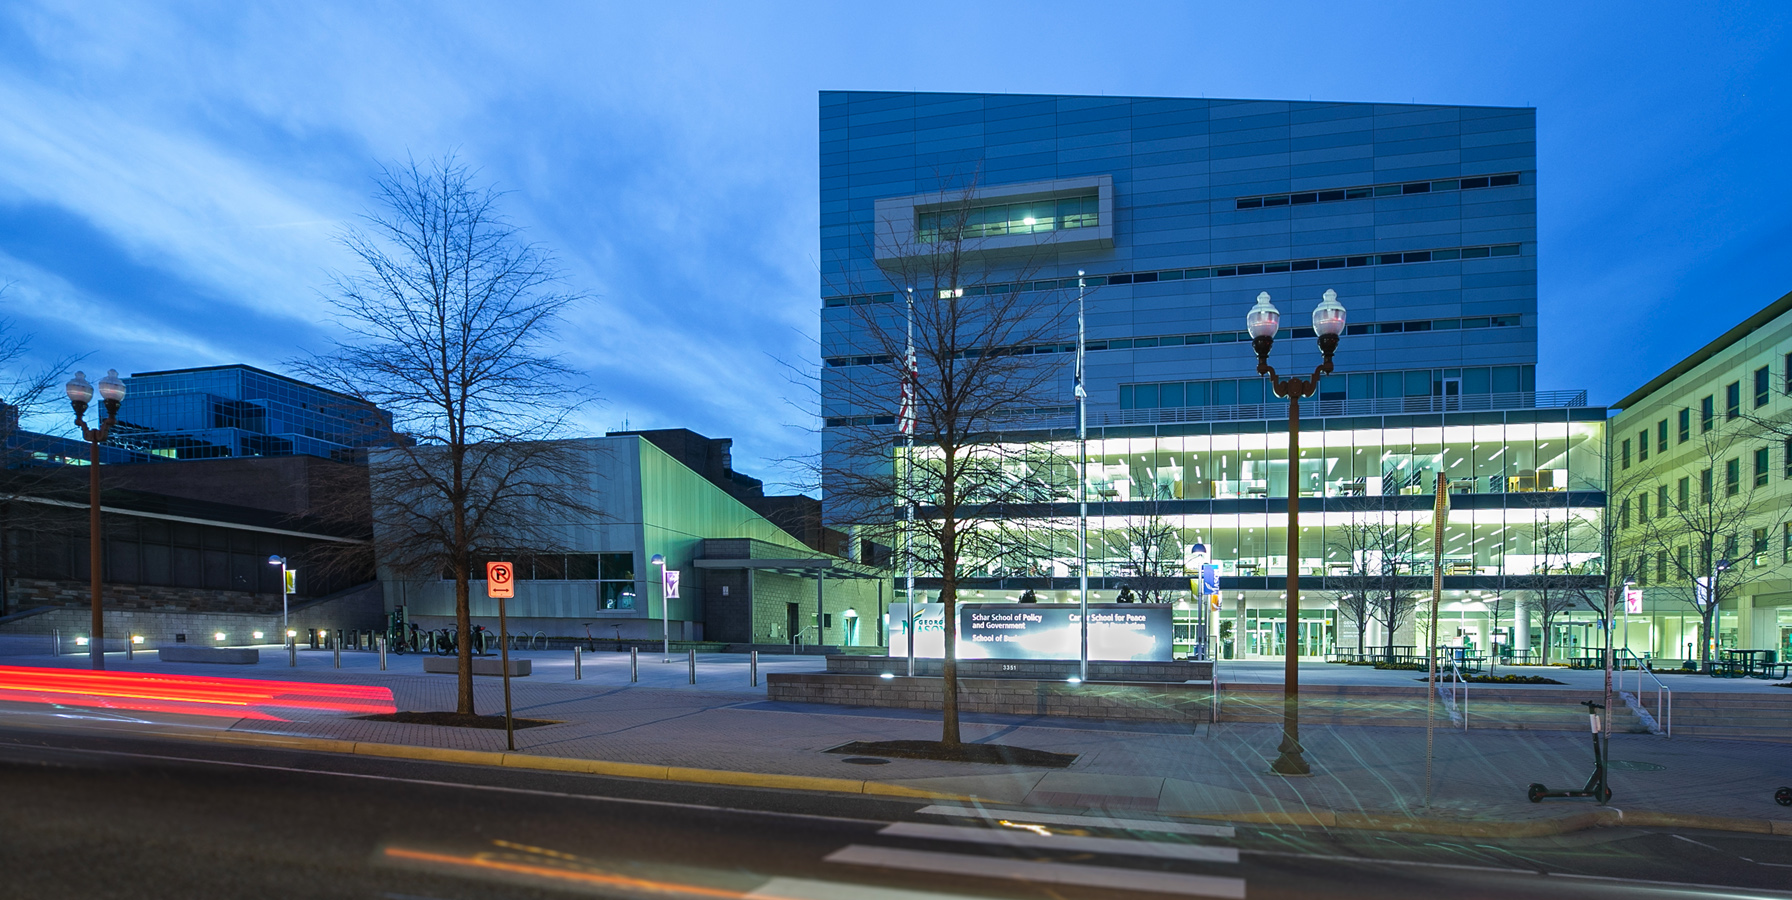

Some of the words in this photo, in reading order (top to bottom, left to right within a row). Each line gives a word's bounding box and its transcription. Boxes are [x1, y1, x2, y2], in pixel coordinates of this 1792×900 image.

[972, 613, 990, 621] Schar
[991, 613, 1013, 621] School
[1014, 613, 1022, 621] of
[1022, 613, 1043, 623] Policy
[1091, 613, 1114, 621] School
[1114, 613, 1126, 621] for
[1126, 613, 1146, 622] Peace
[986, 622, 1026, 630] Government
[972, 634, 994, 642] School
[995, 634, 1002, 642] of
